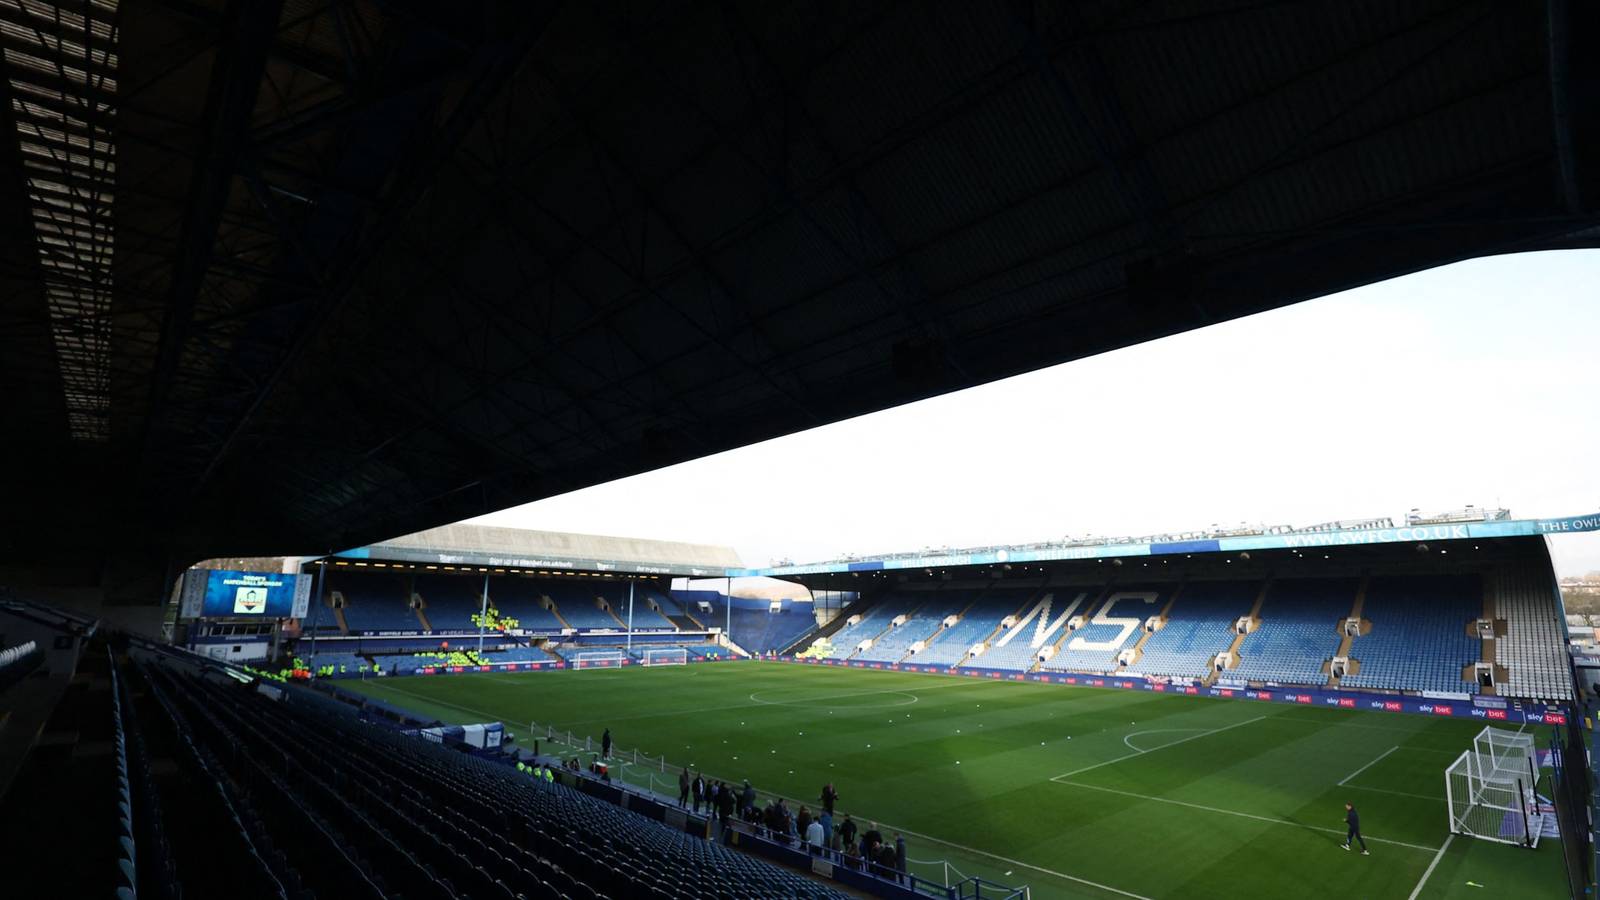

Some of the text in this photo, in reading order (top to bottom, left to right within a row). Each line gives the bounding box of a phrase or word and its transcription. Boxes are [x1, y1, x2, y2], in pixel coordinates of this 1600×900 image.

[1538, 515, 1600, 532] THE OWL
[1284, 526, 1468, 546] WWW.SWFC.CO.UK
[1285, 694, 1310, 703] sky bet
[1326, 698, 1339, 706] sky
[1371, 701, 1400, 710] sky bet
[1420, 705, 1433, 713] sky
[1471, 709, 1505, 718] sky bet
[1527, 713, 1564, 723] sky bet
